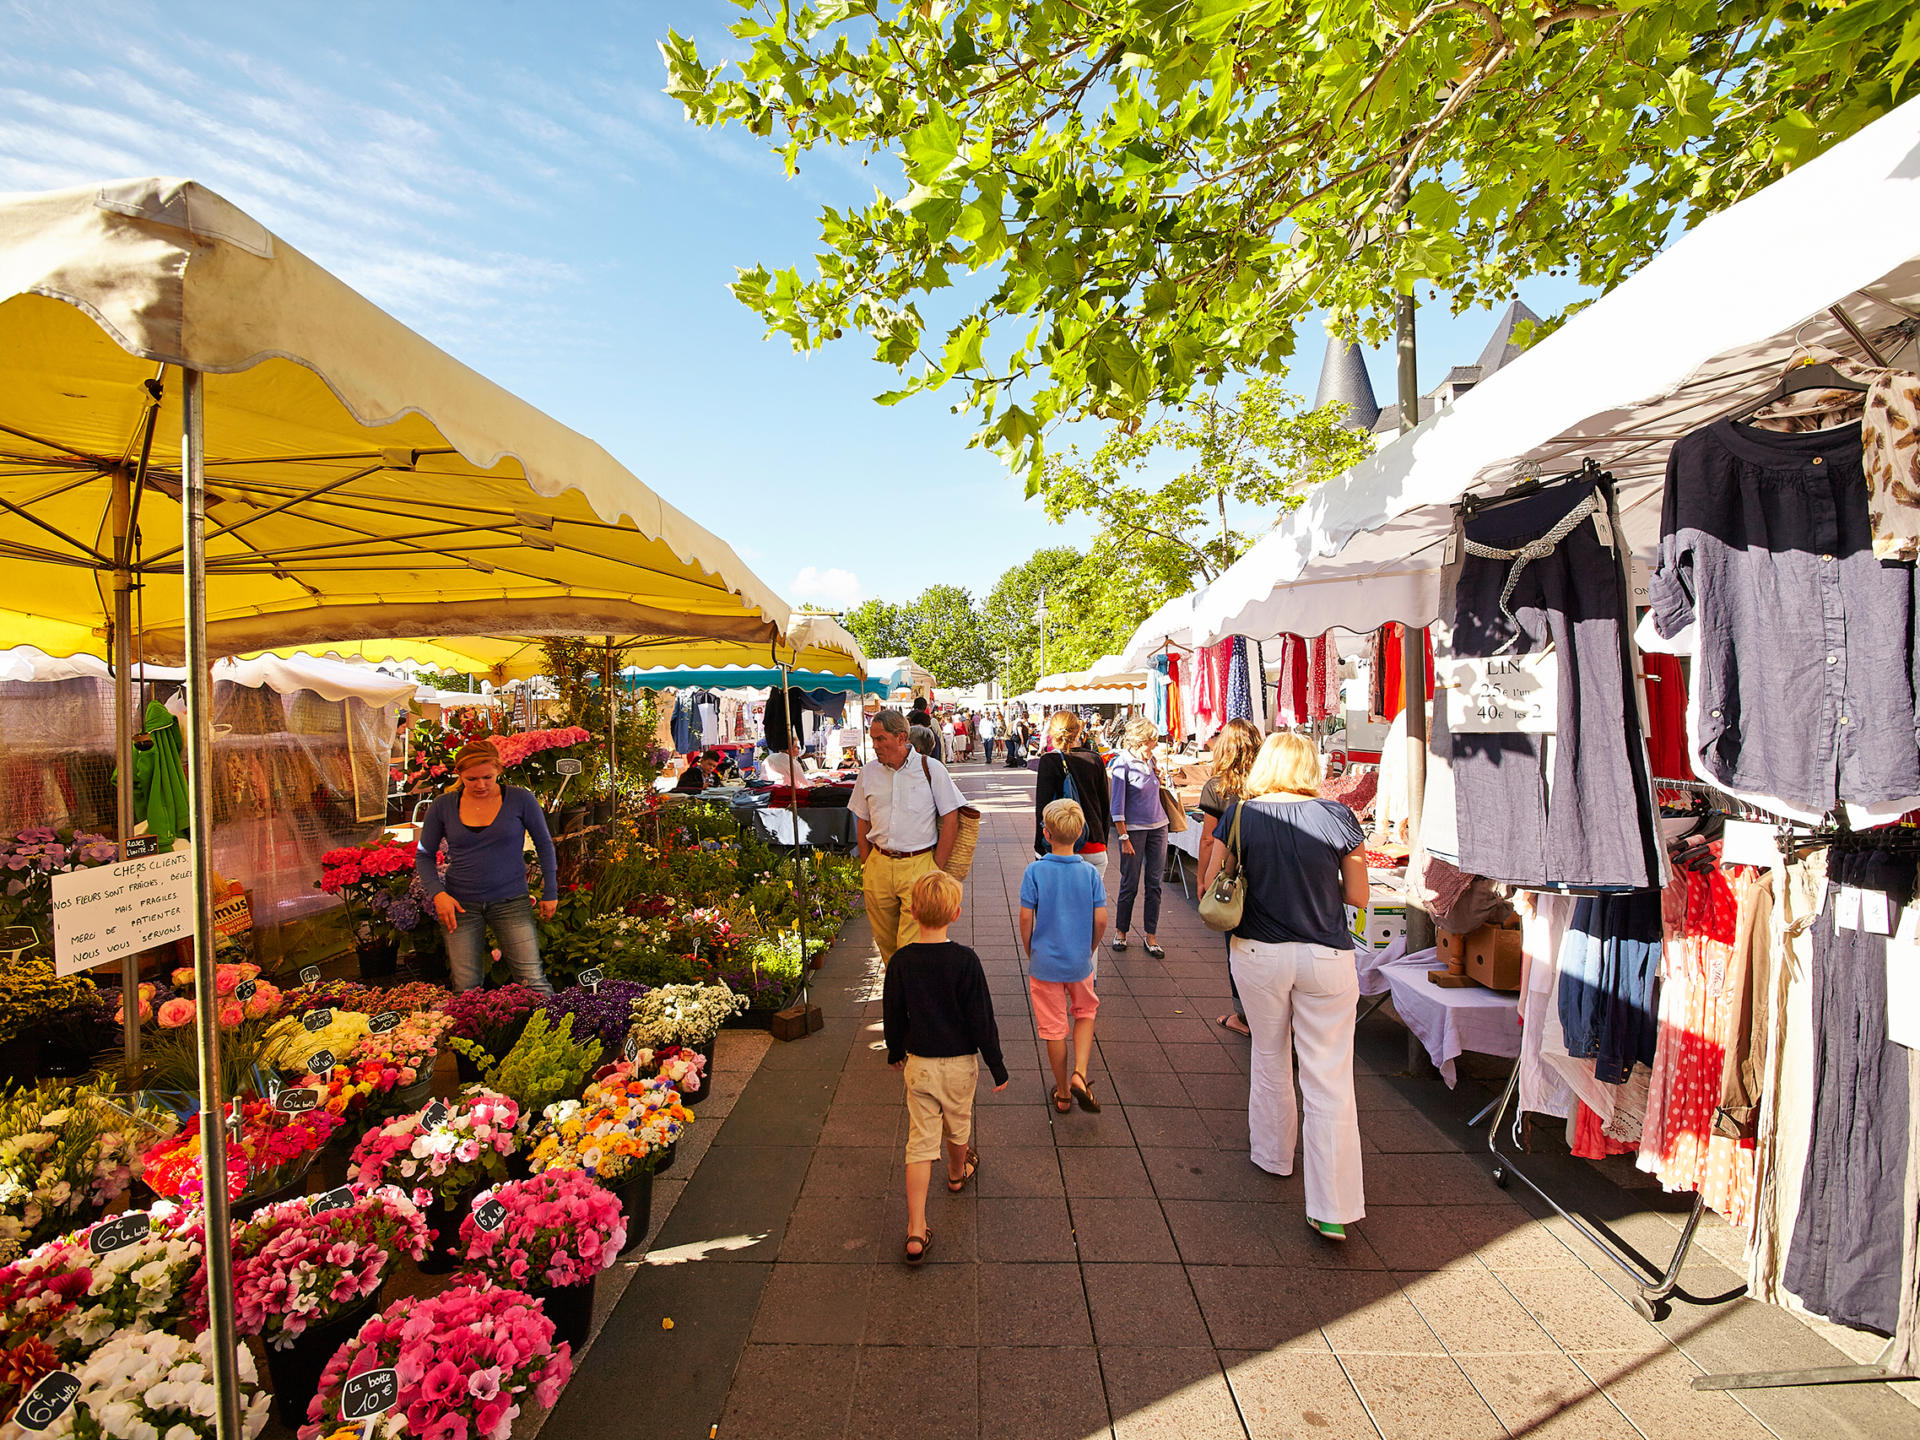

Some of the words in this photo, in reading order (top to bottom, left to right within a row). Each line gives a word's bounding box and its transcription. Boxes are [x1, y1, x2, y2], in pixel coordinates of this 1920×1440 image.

[1487, 659, 1521, 675] LIN
[1481, 683, 1508, 698] 25€
[1477, 705, 1504, 719] 40€
[1514, 711, 1527, 719] les
[1532, 704, 1542, 718] 2
[113, 861, 147, 877] CHERS
[149, 855, 187, 869] CLIENTS
[53, 899, 72, 910] NOS
[75, 892, 102, 905] FLEURS
[104, 886, 124, 899] SONT
[115, 904, 133, 914] MAIS
[140, 892, 177, 907] FRAGILES
[214, 899, 248, 920] mus
[105, 926, 117, 935] DE
[131, 906, 181, 927] PATIENTER
[73, 948, 100, 963] NOUS
[107, 941, 130, 953] VOUS
[142, 924, 181, 942] SERVONS
[368, 1372, 391, 1388] botte
